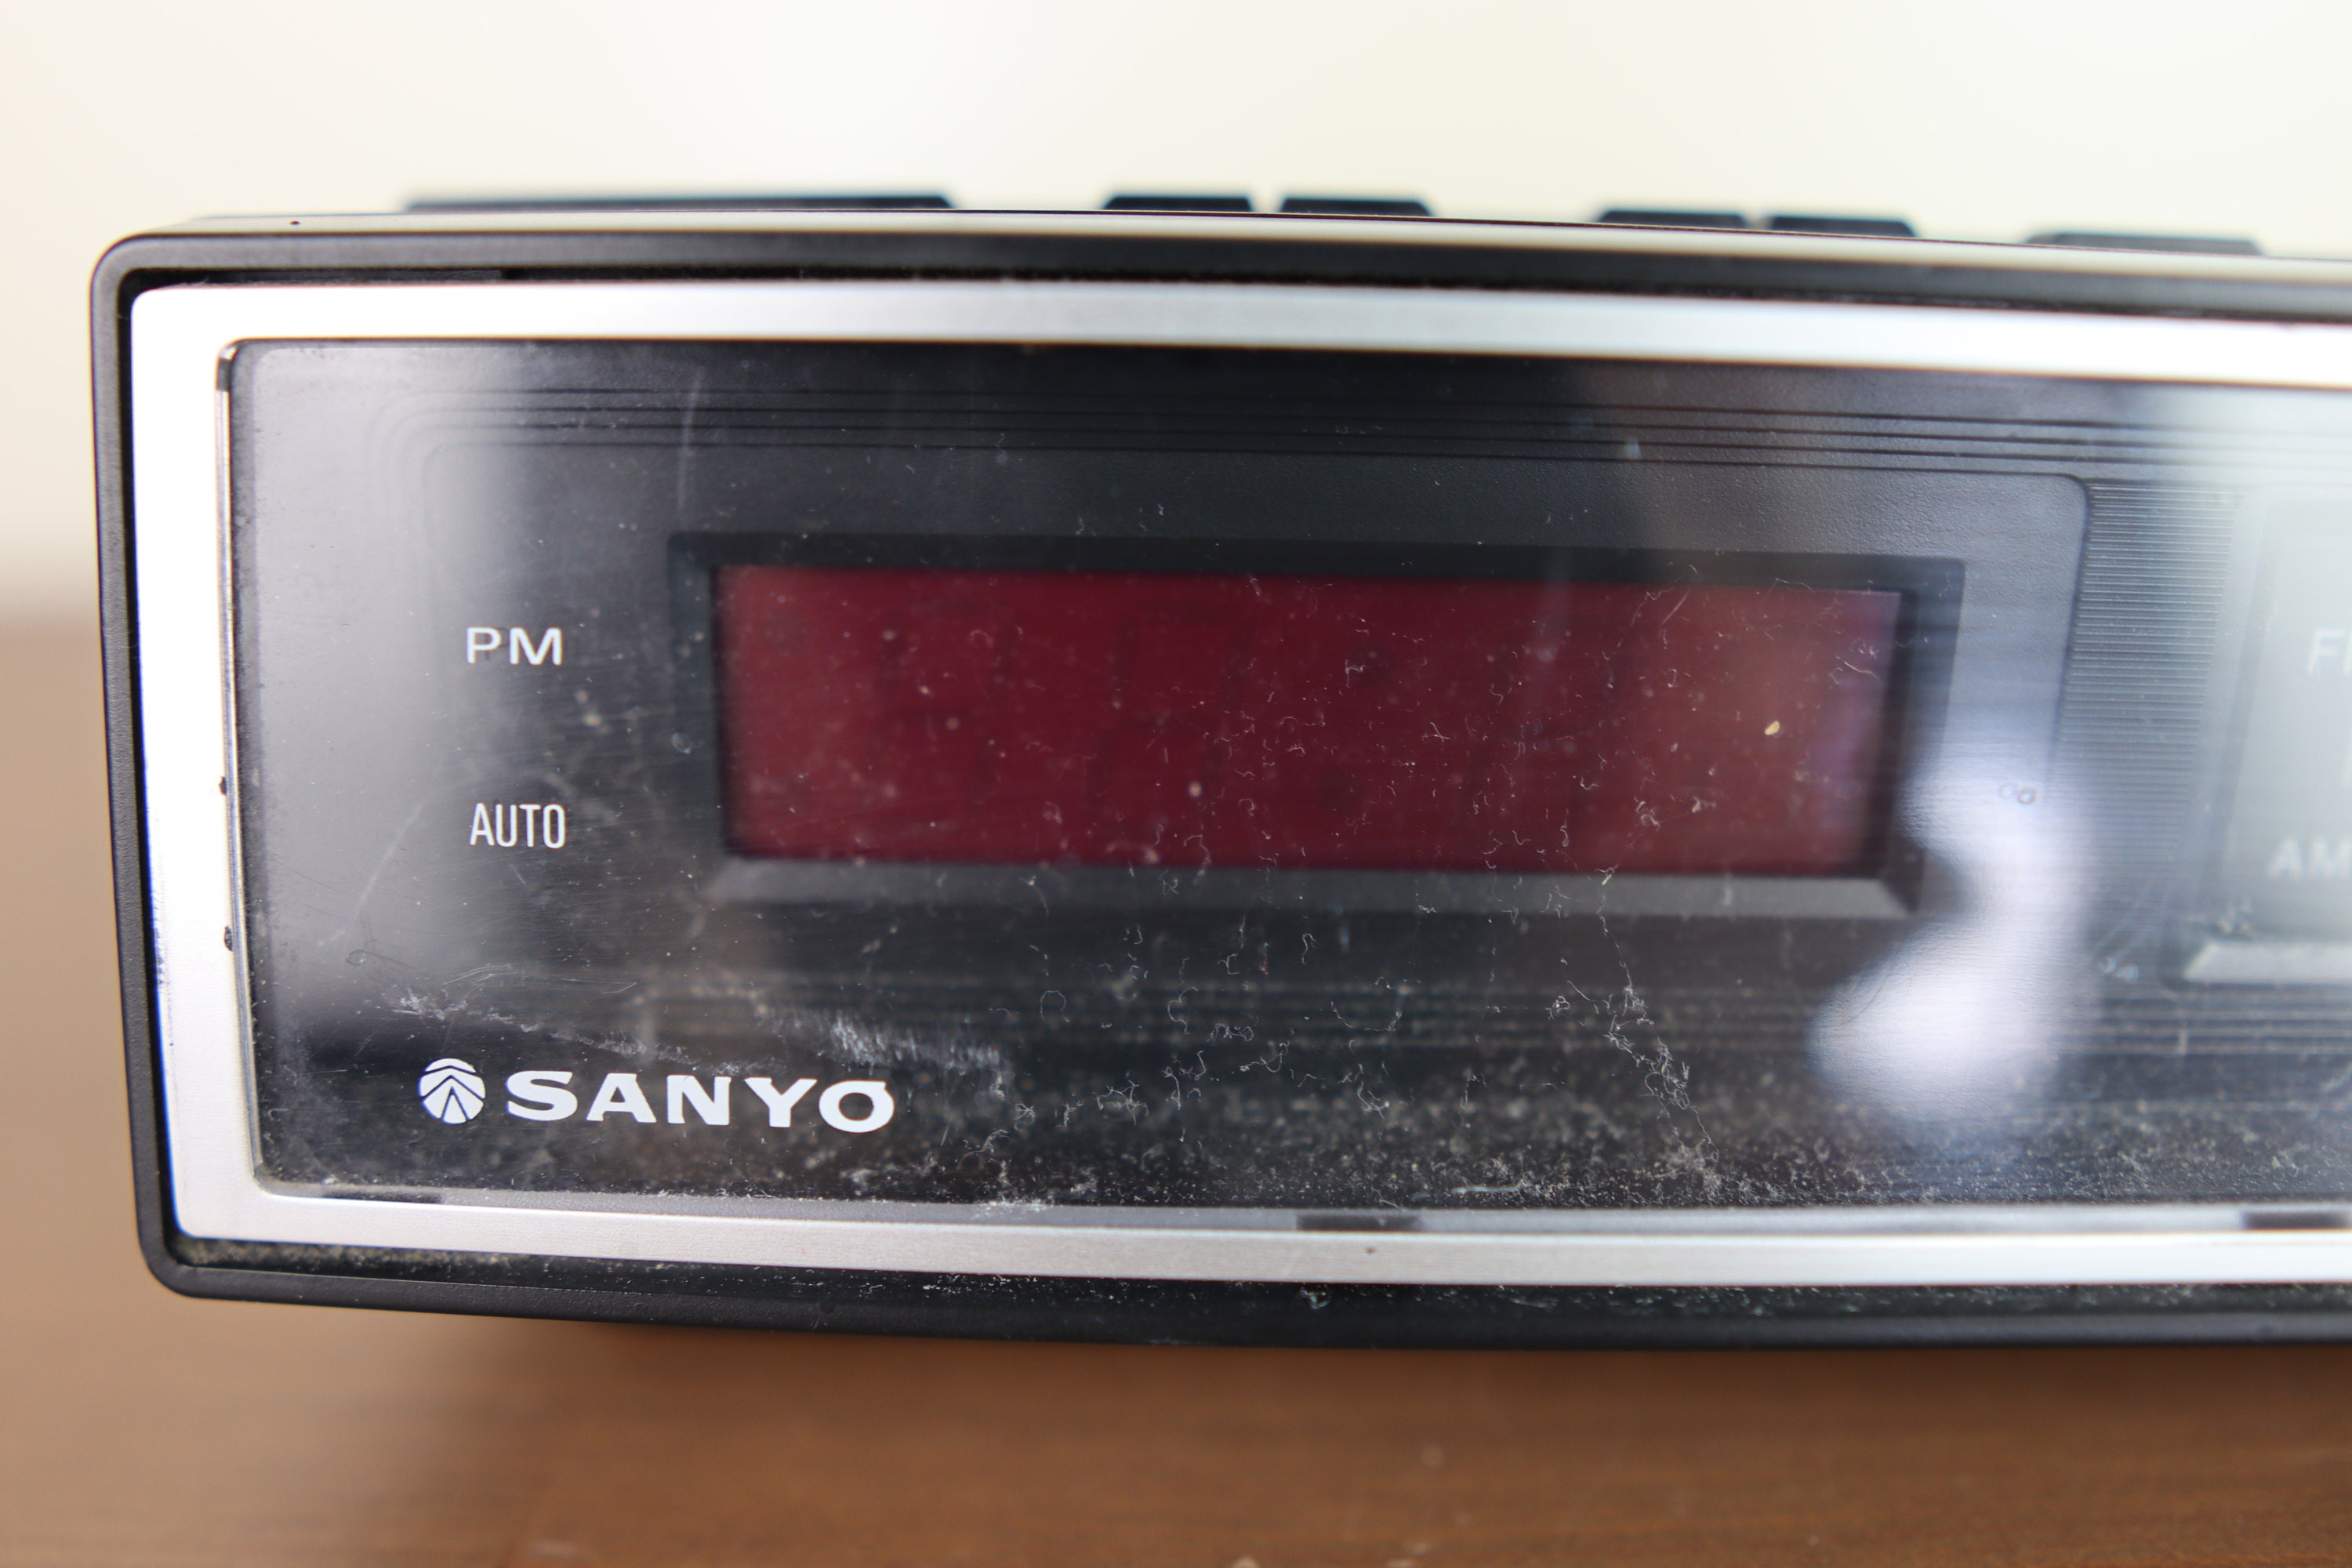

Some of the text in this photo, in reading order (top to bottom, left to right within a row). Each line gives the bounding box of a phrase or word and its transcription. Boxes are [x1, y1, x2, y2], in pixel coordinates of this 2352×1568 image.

[466, 626, 563, 665] PM
[2307, 626, 2352, 675] F
[470, 803, 567, 848] AUTO
[506, 1070, 895, 1134] SANYO
